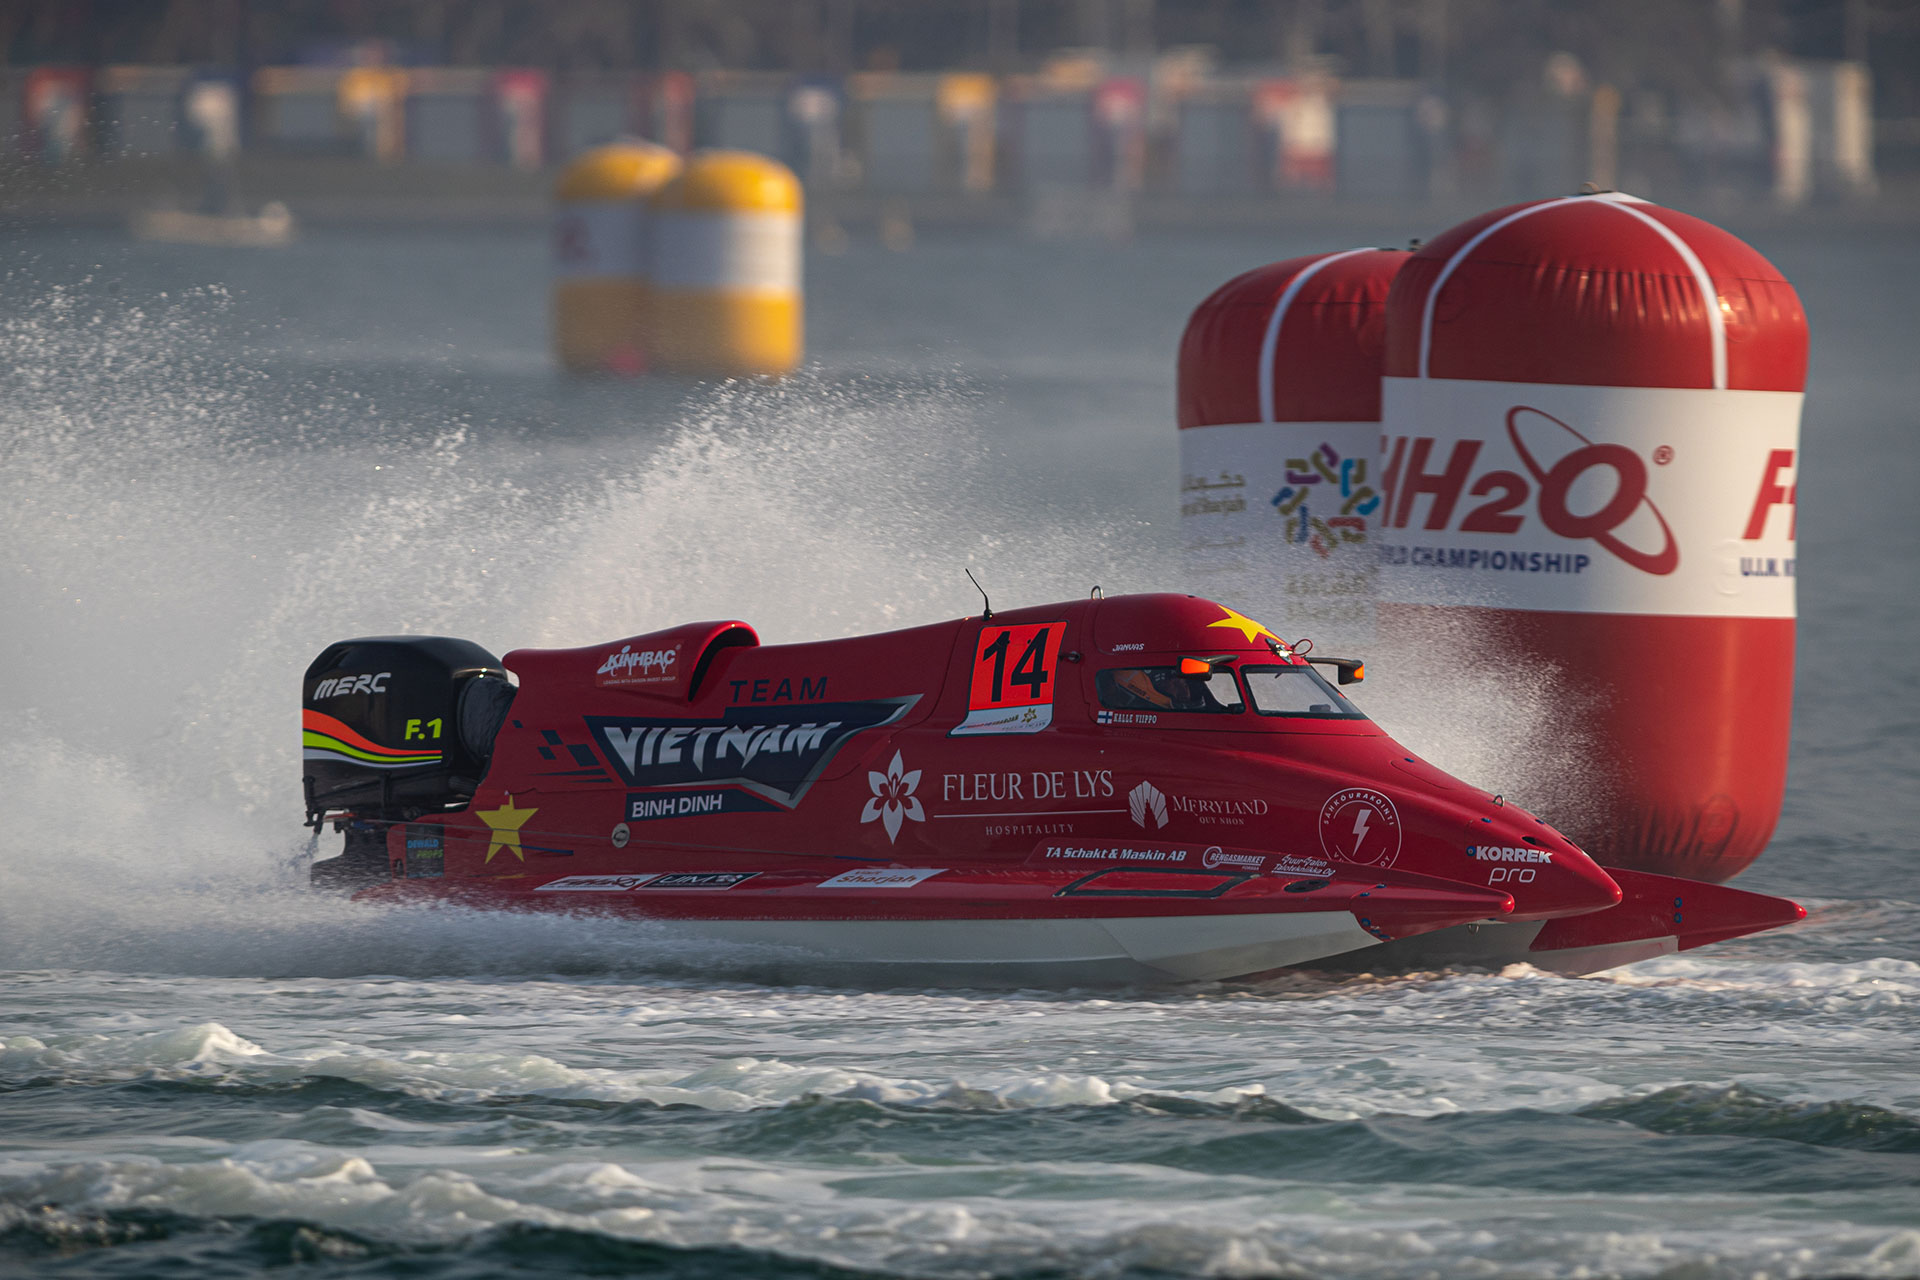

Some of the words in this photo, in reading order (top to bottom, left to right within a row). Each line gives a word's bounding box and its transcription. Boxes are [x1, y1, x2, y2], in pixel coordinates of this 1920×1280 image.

[1411, 547, 1591, 573] CHAMPIONSHIP
[1112, 643, 1145, 652] JANVAS
[982, 628, 1051, 703] 14
[313, 672, 392, 701] MERC
[729, 676, 829, 703] TEAM
[1113, 713, 1133, 723] KALLE
[405, 718, 443, 740] F.1
[603, 721, 844, 777] VIETNAM
[943, 773, 1024, 801] FLEUR
[1032, 771, 1066, 799] DE
[1073, 770, 1114, 798] LYS
[632, 797, 676, 818] BINH
[678, 794, 723, 815] DINH
[1173, 795, 1268, 816] MERRYLAND
[985, 824, 1075, 836] HOSPITALITY
[1200, 816, 1216, 825] QUY
[1045, 847, 1060, 858] TA
[1063, 847, 1108, 859] Schakt
[1108, 848, 1119, 859] &
[1120, 848, 1166, 860] Maskin
[1167, 850, 1187, 861] AB
[1476, 845, 1553, 863] KORREK
[1488, 868, 1536, 886] pro
